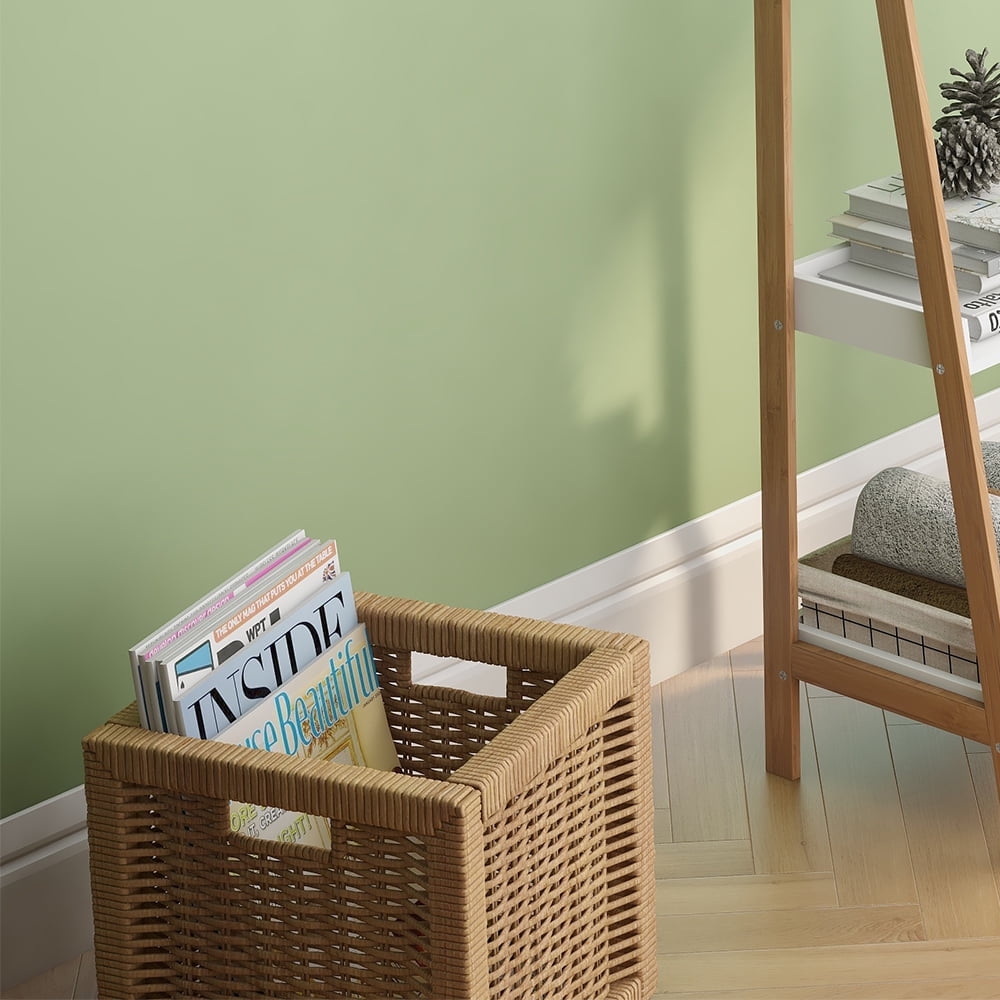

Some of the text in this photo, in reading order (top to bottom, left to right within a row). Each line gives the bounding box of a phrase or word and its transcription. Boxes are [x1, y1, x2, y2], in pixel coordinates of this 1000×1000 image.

[215, 625, 229, 638] THE
[227, 614, 243, 629] ONLY
[242, 605, 257, 620] MAG
[256, 593, 271, 611] THAT
[270, 582, 286, 601] PUTS
[284, 574, 298, 589] YOU
[296, 567, 306, 581] AT
[304, 558, 317, 573] THE
[315, 545, 333, 565] TABLE
[246, 617, 267, 642] WPT
[187, 591, 345, 740] INSIDE
[274, 627, 380, 756] Beautiful
